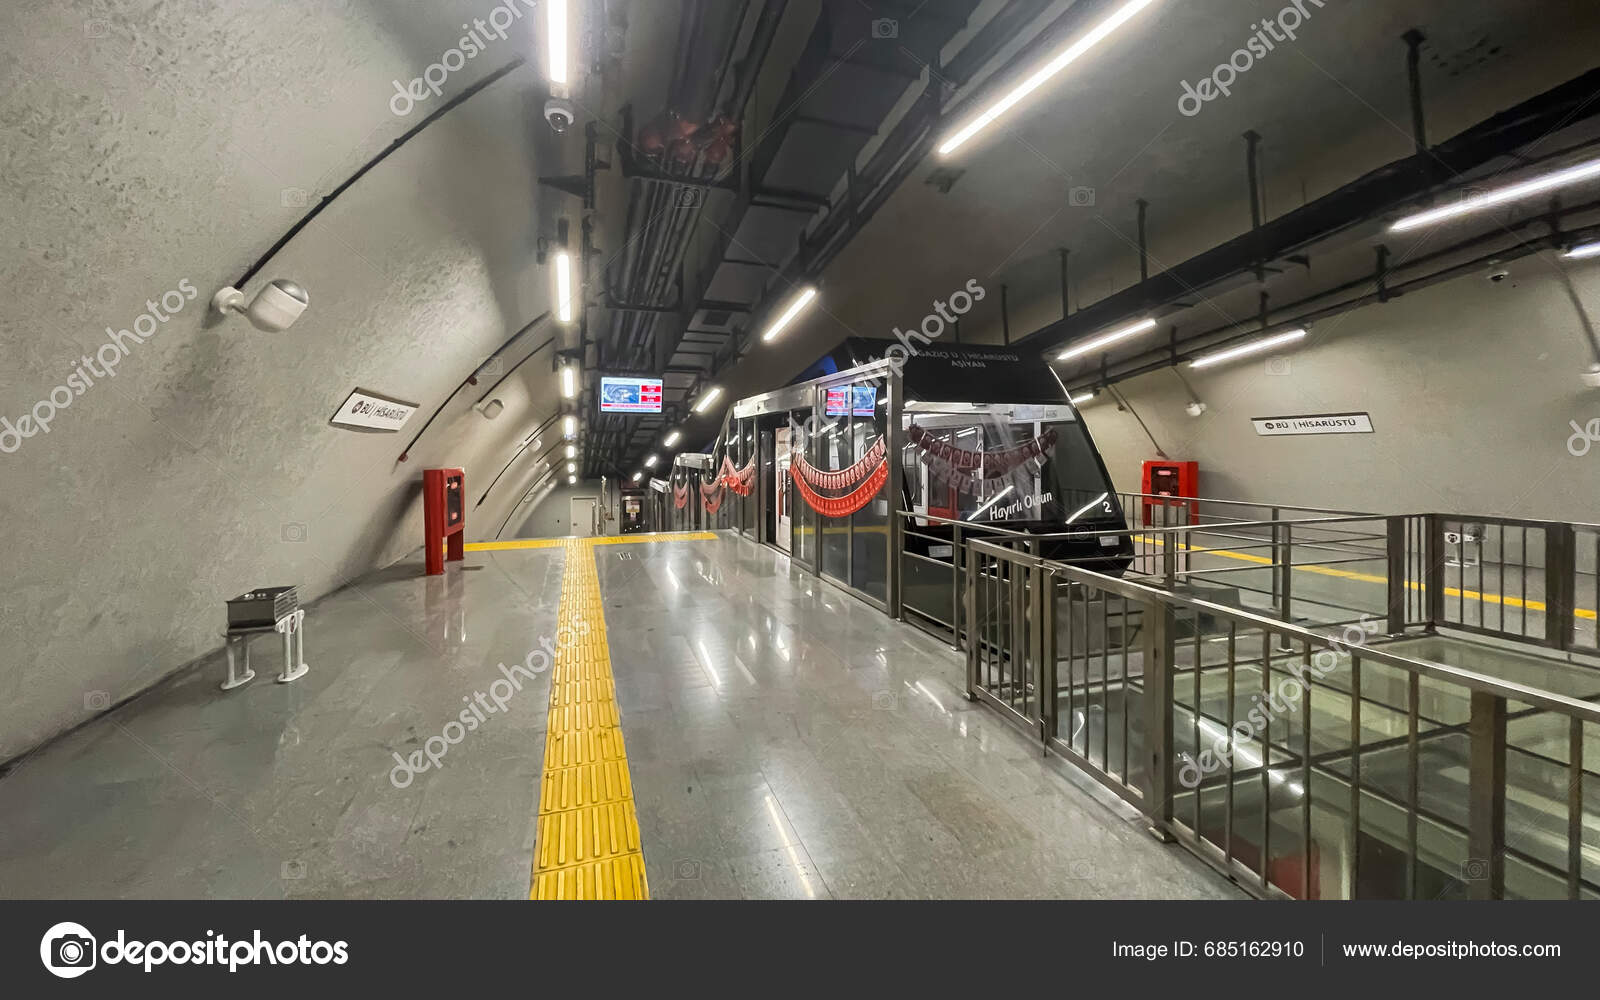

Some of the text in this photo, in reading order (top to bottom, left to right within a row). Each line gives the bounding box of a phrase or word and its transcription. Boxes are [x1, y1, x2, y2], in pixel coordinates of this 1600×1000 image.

[1299, 418, 1357, 428] HİSARÜSTÜ
[989, 499, 1023, 521] Hayırlı
[1102, 501, 1113, 513] 2
